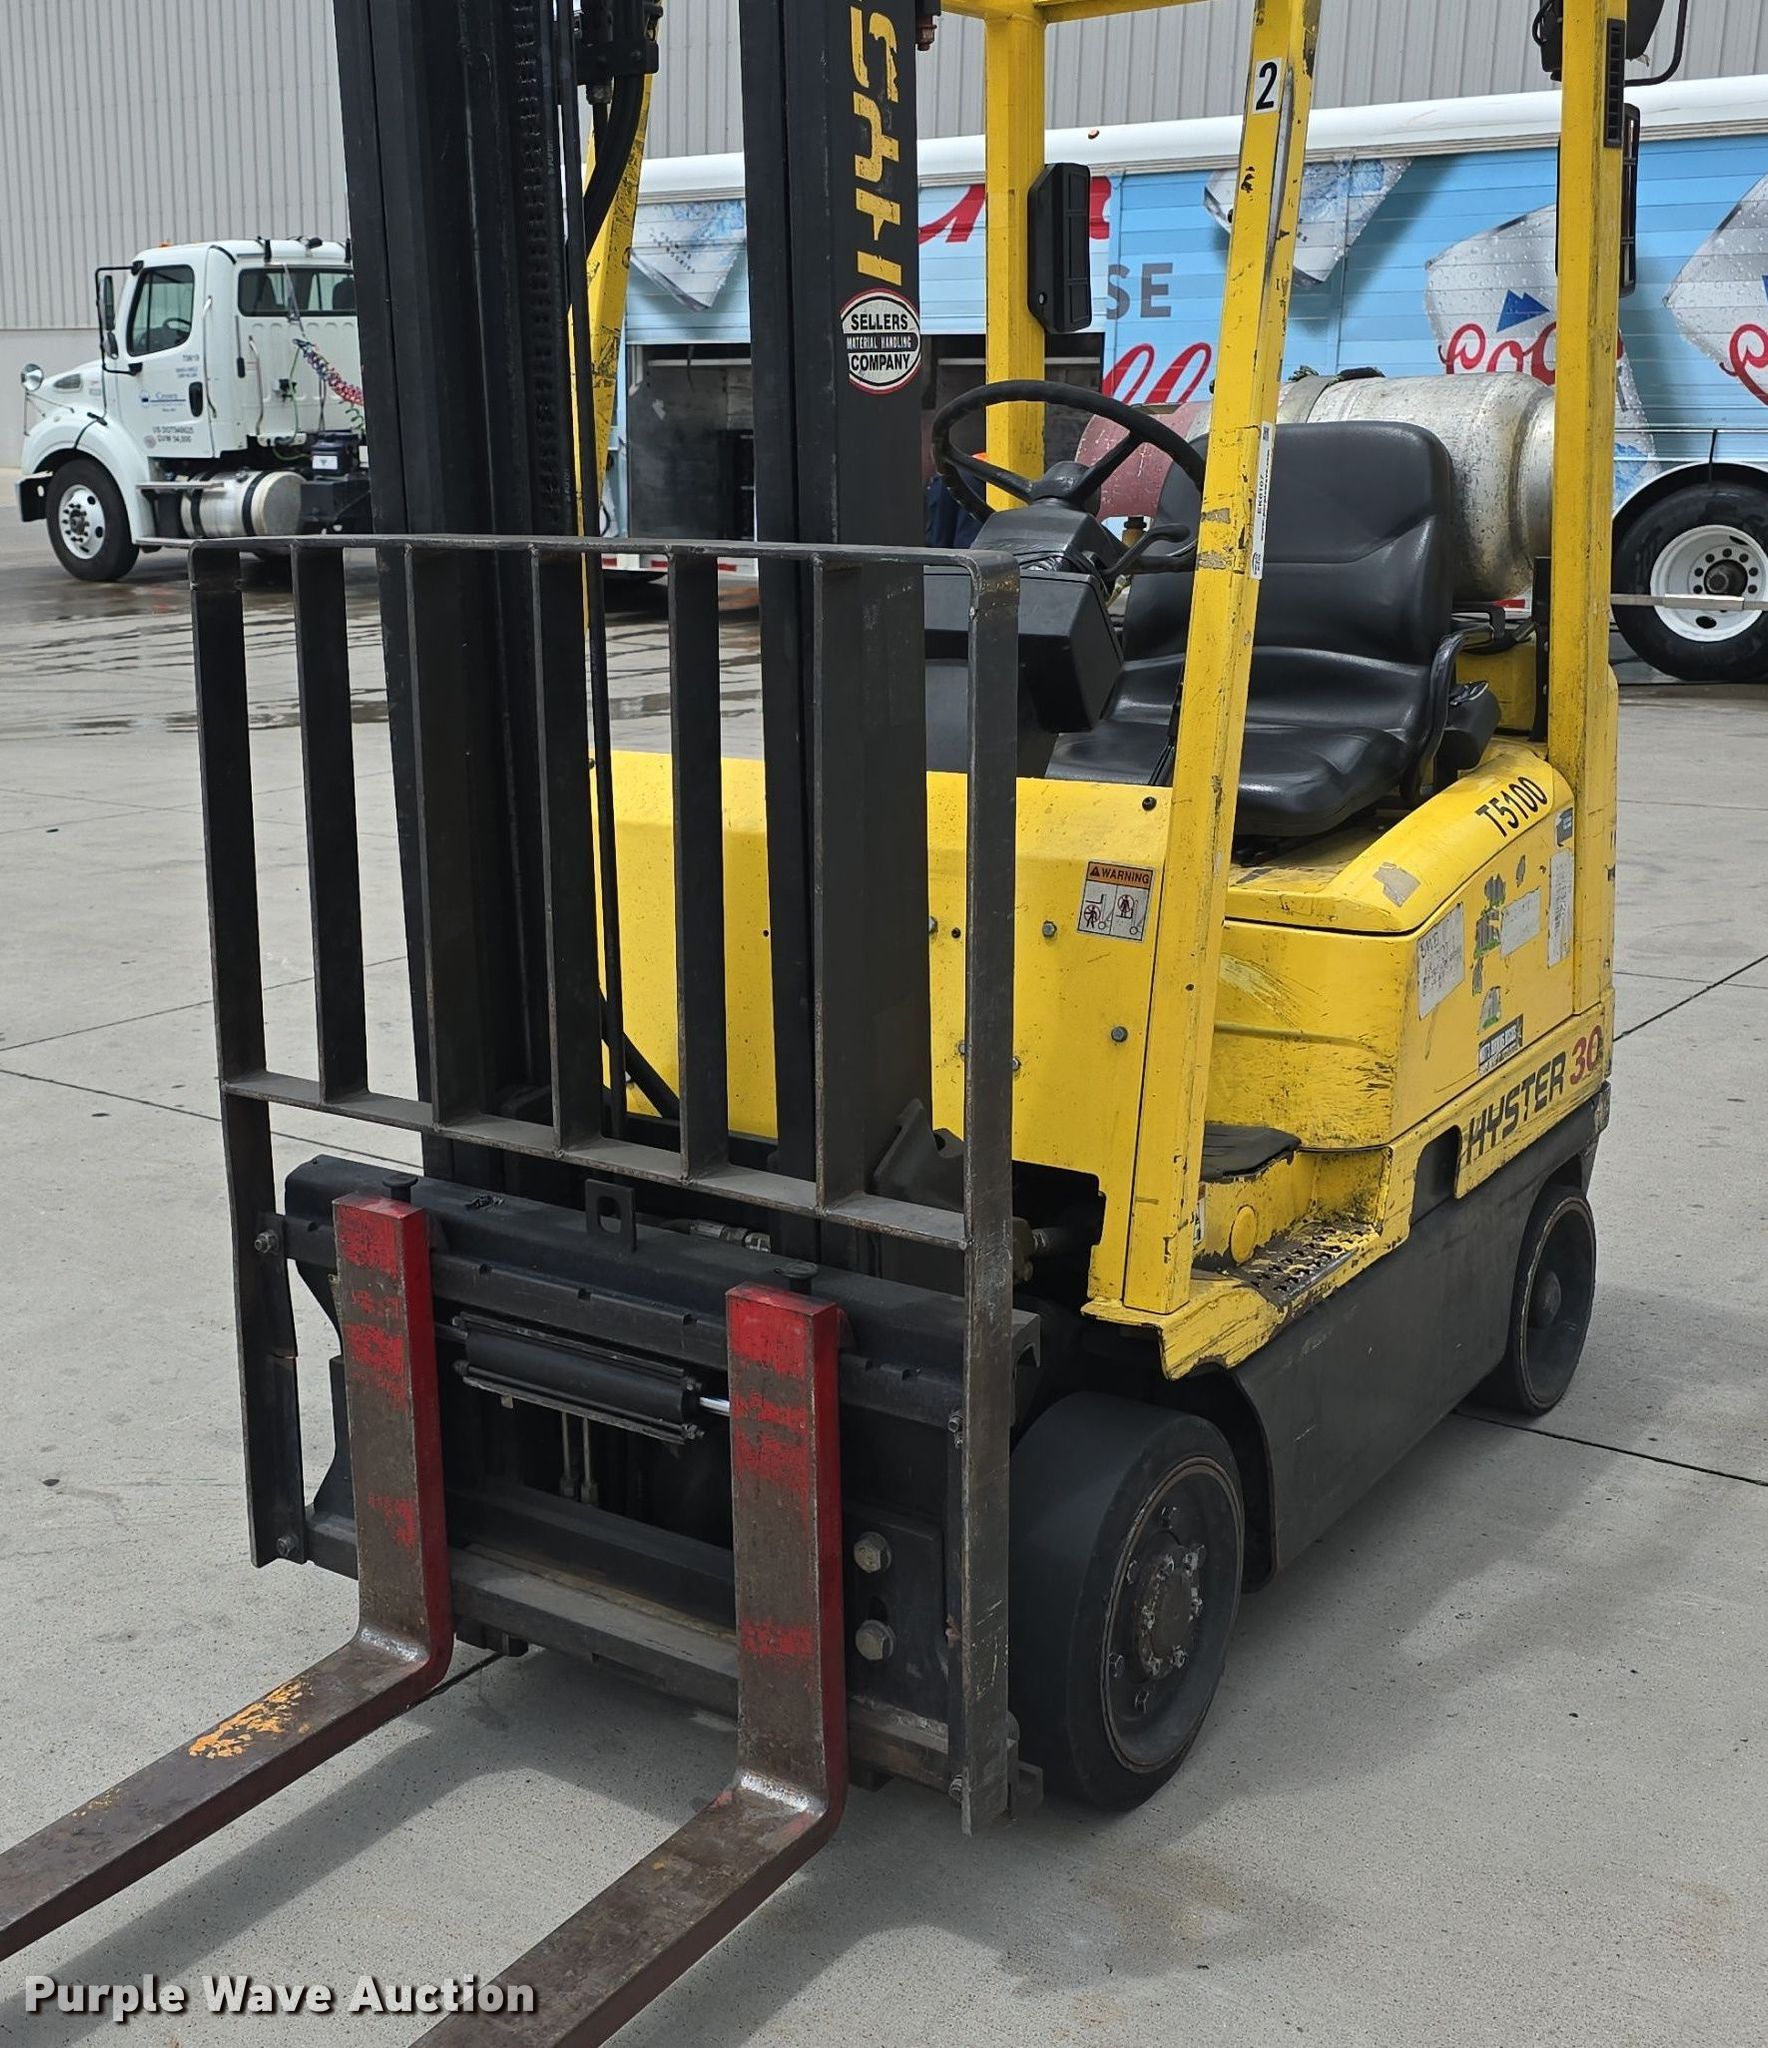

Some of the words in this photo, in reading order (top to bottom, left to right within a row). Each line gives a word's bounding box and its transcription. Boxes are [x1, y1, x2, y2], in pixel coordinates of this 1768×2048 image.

[1256, 61, 1278, 111] 2
[851, 314, 908, 330] SELLERS
[846, 335, 878, 350] MATERIAL
[880, 335, 912, 350] HANDLING
[851, 354, 910, 371] COMPANY
[1475, 776, 1548, 837] T5100
[1102, 868, 1150, 884] WARNING
[1466, 1051, 1566, 1165] HYSTER
[1570, 1025, 1603, 1086] 30
